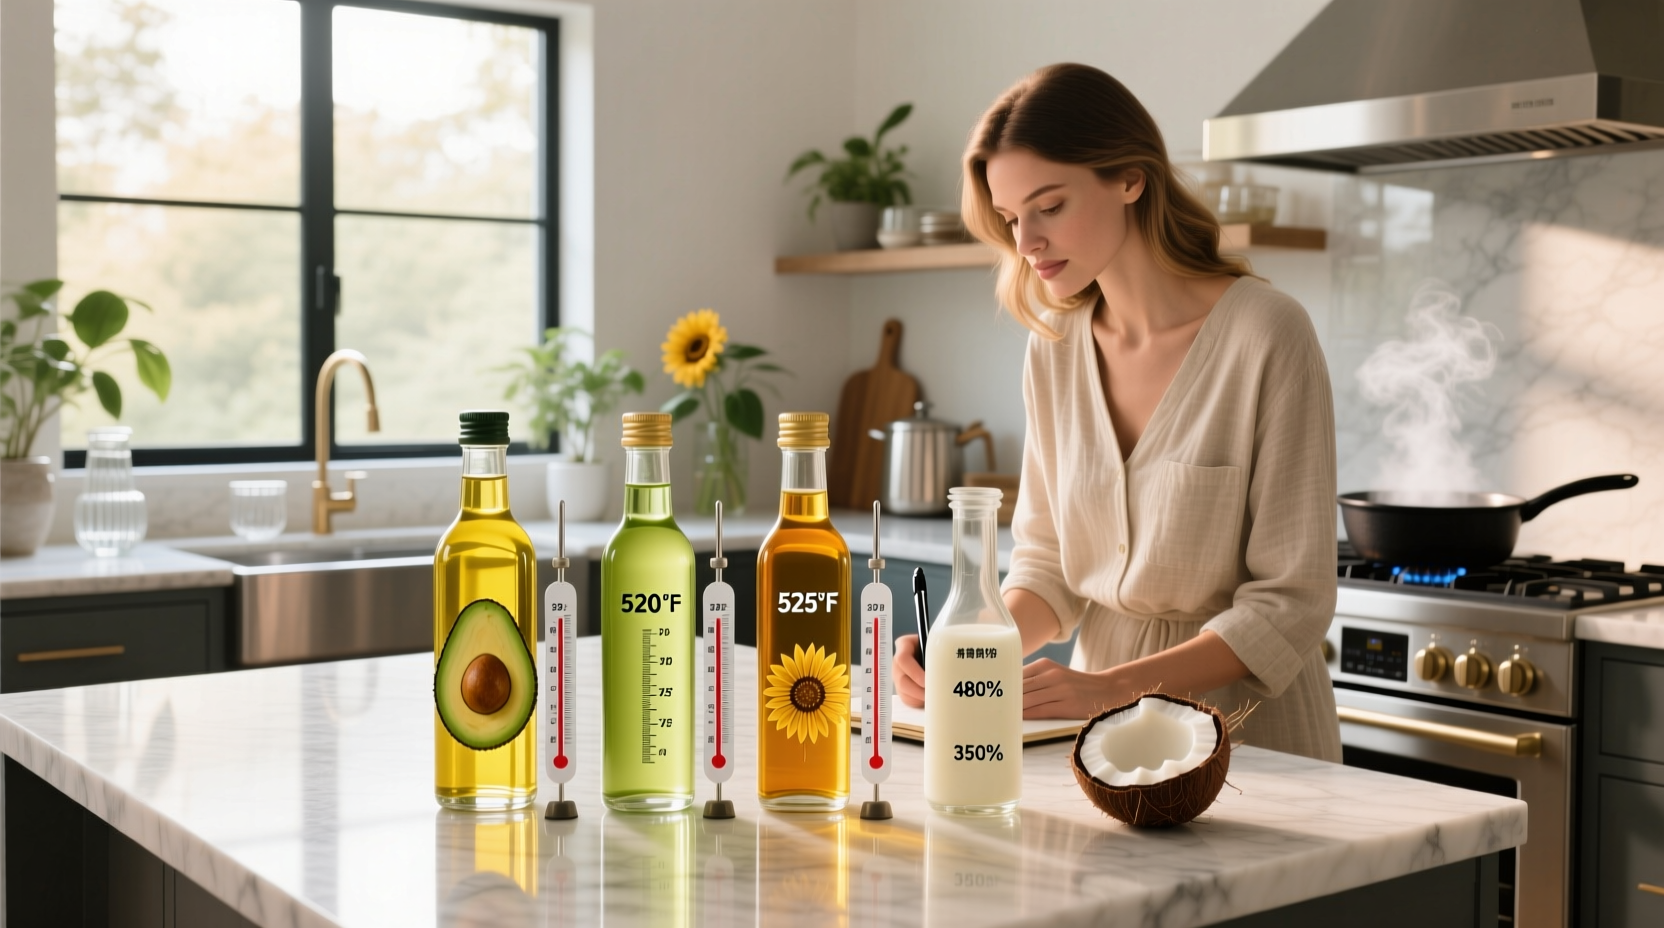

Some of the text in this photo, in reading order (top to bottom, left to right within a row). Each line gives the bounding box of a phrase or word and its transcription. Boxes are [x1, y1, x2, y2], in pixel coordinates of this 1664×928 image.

[621, 593, 682, 613] 520°F
[778, 592, 839, 613] 525°F
[953, 680, 1003, 697] 480%
[954, 744, 1004, 761] 350%
